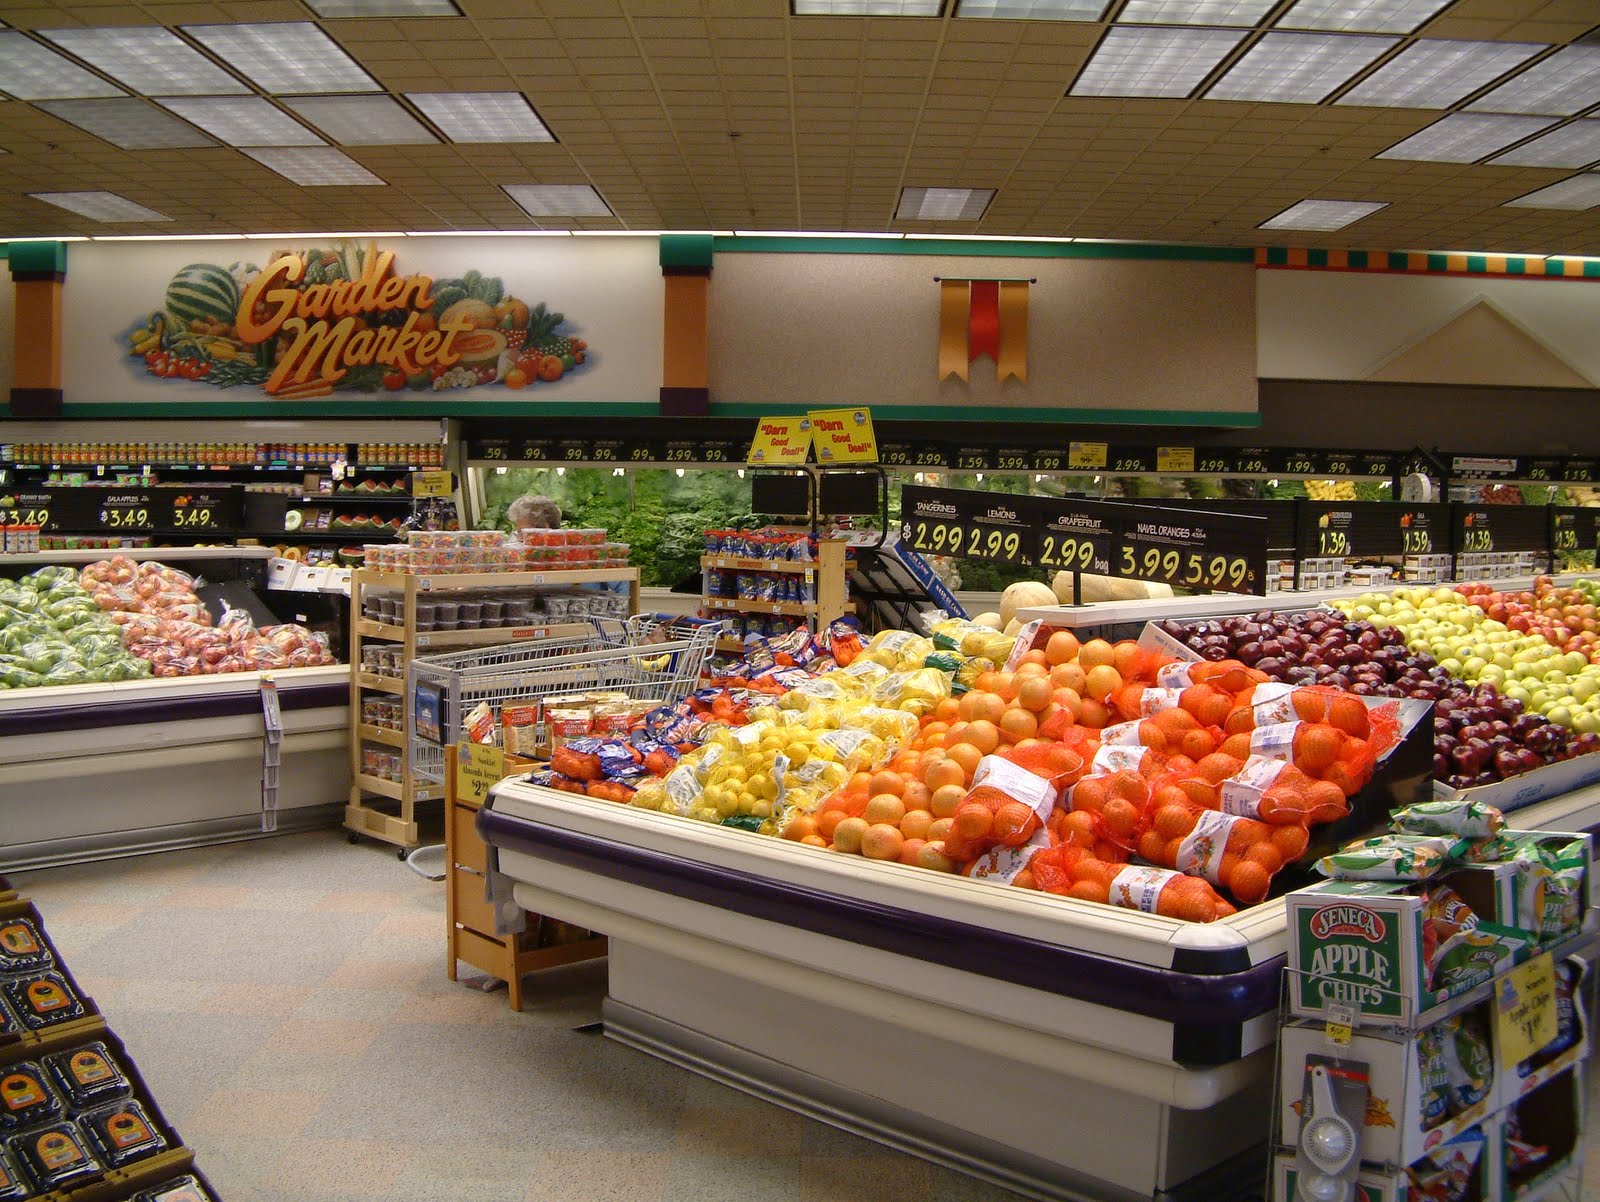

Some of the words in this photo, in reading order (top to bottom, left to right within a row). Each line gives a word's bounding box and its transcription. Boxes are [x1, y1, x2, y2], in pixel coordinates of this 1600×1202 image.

[235, 250, 434, 343] Garden
[262, 311, 475, 393] Market
[770, 437, 789, 446] Good
[831, 433, 851, 443] Good
[667, 450, 691, 461] 2.99
[917, 453, 940, 465] 2.99
[1115, 460, 1140, 471] 2.99
[174, 509, 210, 527] 3.49
[917, 502, 957, 514] TANGERINES
[987, 509, 1017, 520] LEMONS
[1058, 516, 1103, 528] GRAPEFRUIT
[1137, 524, 1158, 535] NAVEL
[1158, 525, 1190, 538] ORANGES
[968, 528, 1020, 560] 2.99
[1320, 532, 1346, 555] 1.39
[1405, 530, 1428, 552] 1.39
[1040, 536, 1094, 570] 2.99
[1095, 557, 1109, 574] bag
[1120, 546, 1180, 580] 3.99
[1186, 555, 1247, 588] 5.99
[1318, 907, 1377, 937] SENECA
[1308, 944, 1392, 988] APPLE
[1319, 981, 1383, 1005] CHIPS
